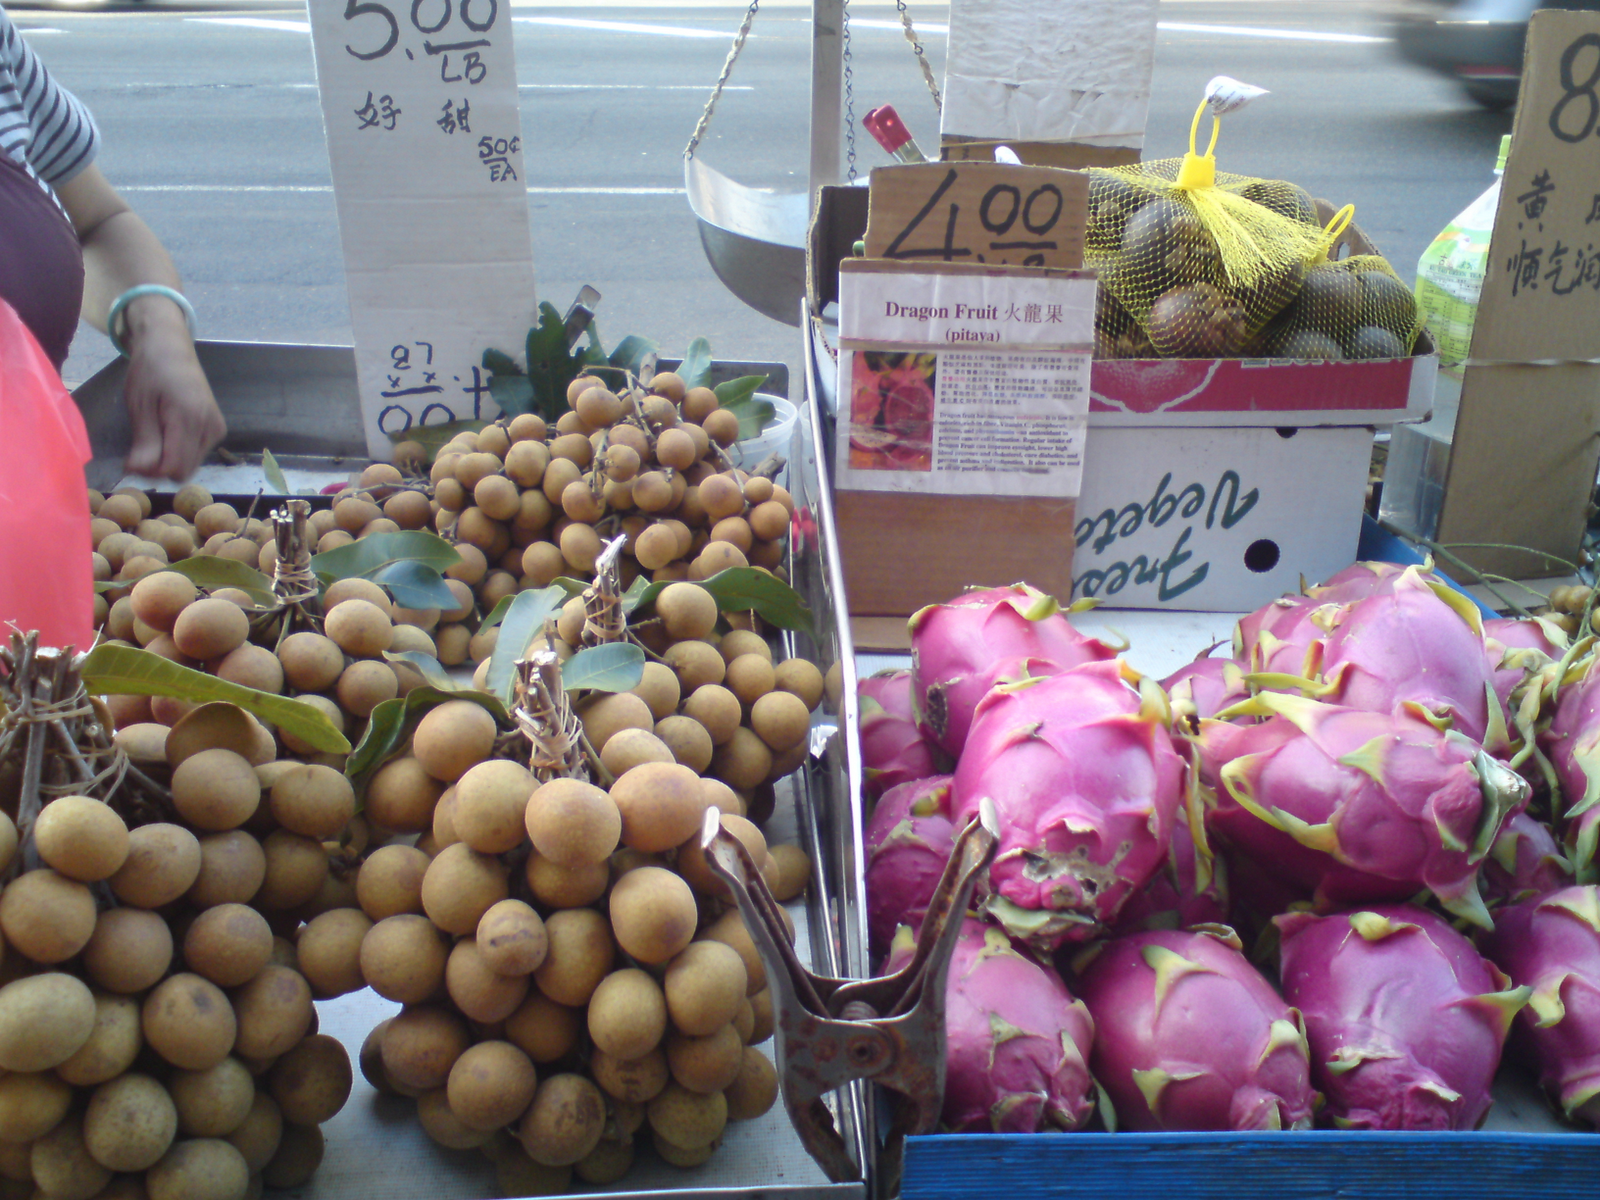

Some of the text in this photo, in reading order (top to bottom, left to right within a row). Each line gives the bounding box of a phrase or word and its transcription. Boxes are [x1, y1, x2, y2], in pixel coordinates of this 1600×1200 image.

[344, 0, 498, 61] 5.00
[441, 51, 487, 84] LB
[354, 91, 471, 134] 好 甜
[490, 164, 517, 182] EA
[882, 168, 1063, 264] 4.00
[885, 301, 1064, 324] Dragon Fruit 火龍果
[1070, 526, 1210, 602] Fres
